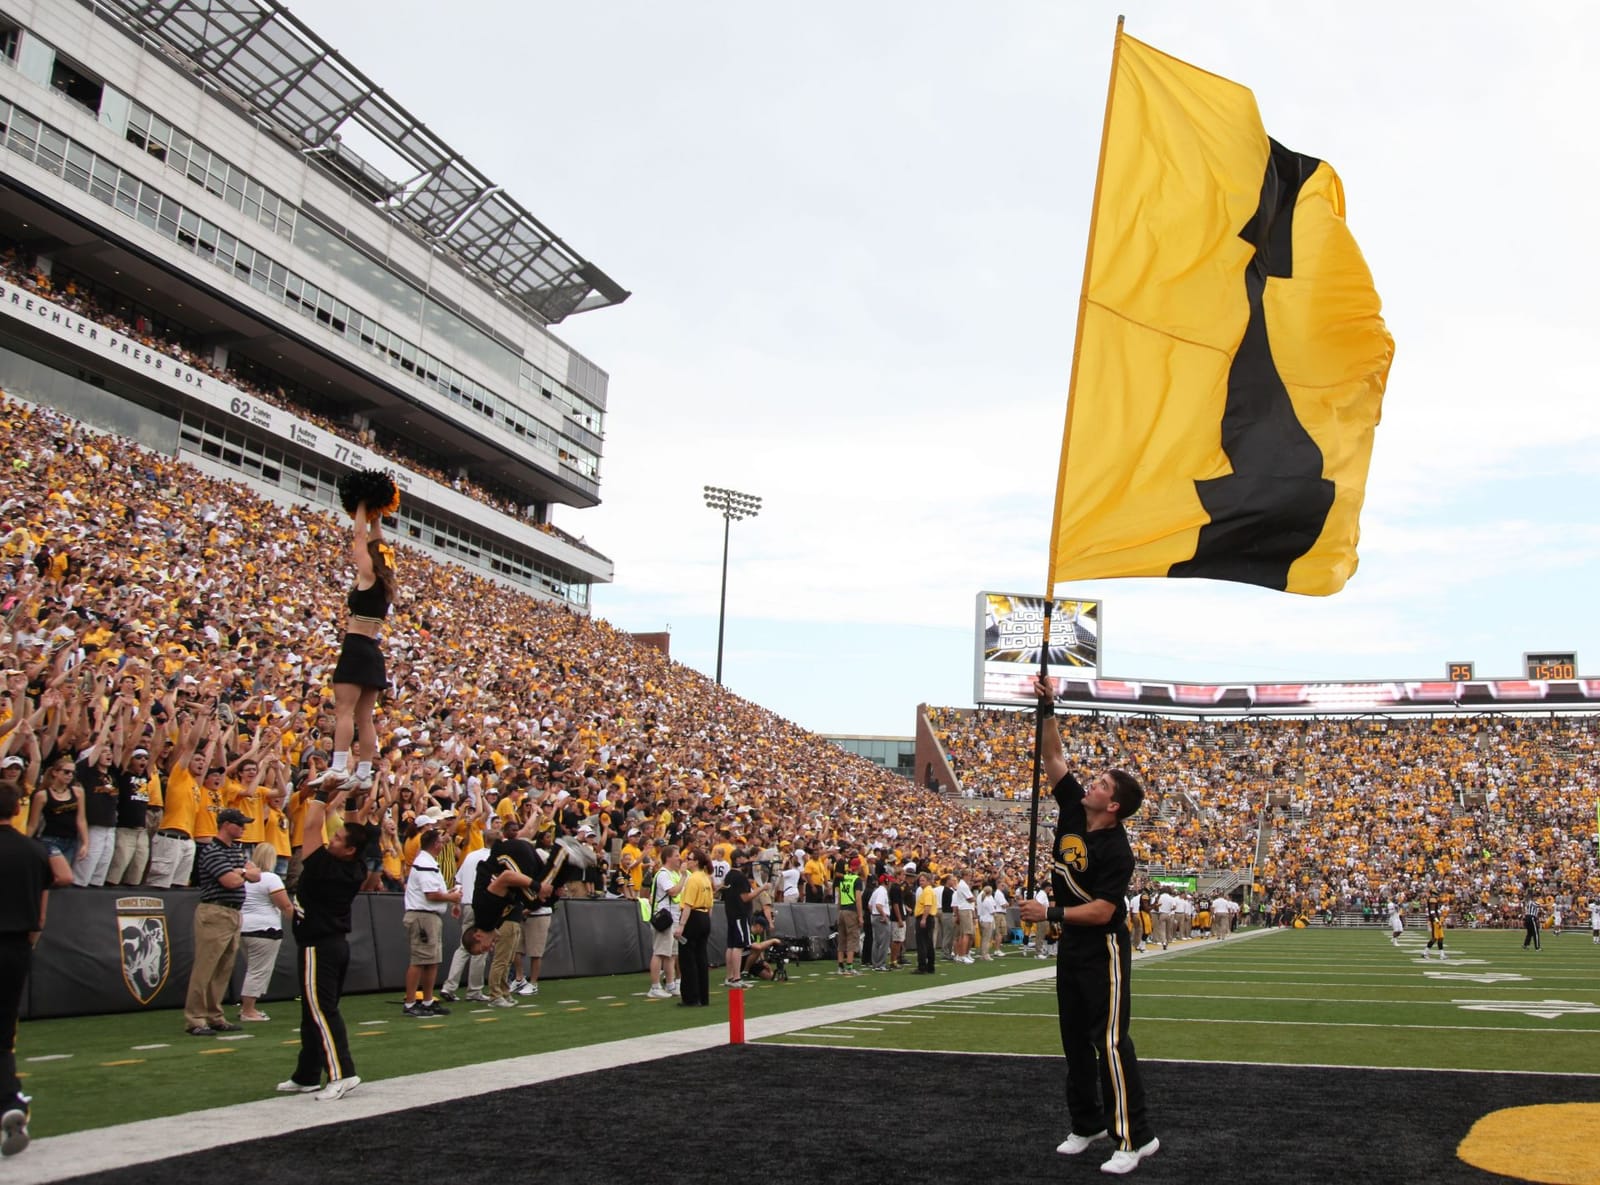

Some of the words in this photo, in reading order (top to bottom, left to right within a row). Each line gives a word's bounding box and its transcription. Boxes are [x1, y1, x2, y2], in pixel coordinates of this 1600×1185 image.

[0, 287, 97, 339] BRECHLER
[110, 338, 162, 369] PRESS
[174, 368, 203, 388] BOX
[231, 397, 250, 419] 62
[253, 406, 271, 420] Calvin
[251, 415, 270, 428] Jones
[290, 424, 296, 439] 1
[335, 443, 350, 462] 77
[1452, 666, 1471, 681] 25
[1536, 664, 1573, 680] 15:00
[714, 865, 725, 878] 16
